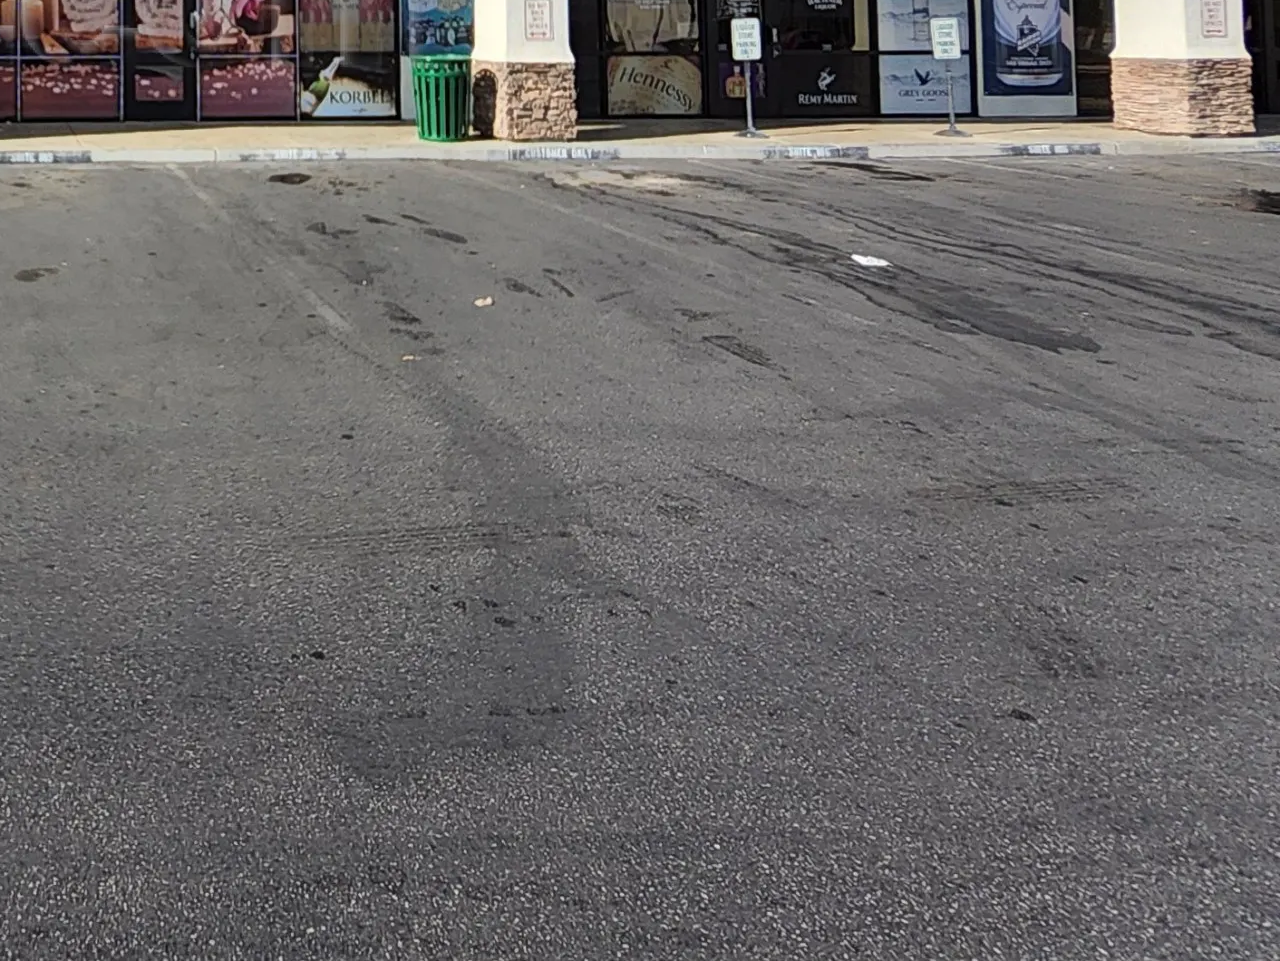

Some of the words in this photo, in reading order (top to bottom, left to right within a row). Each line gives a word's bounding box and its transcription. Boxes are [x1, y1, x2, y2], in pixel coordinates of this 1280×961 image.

[619, 66, 695, 113] Hennessy
[898, 89, 920, 98] GREY
[921, 89, 949, 98] GOOS
[823, 93, 858, 104] MARTIN
